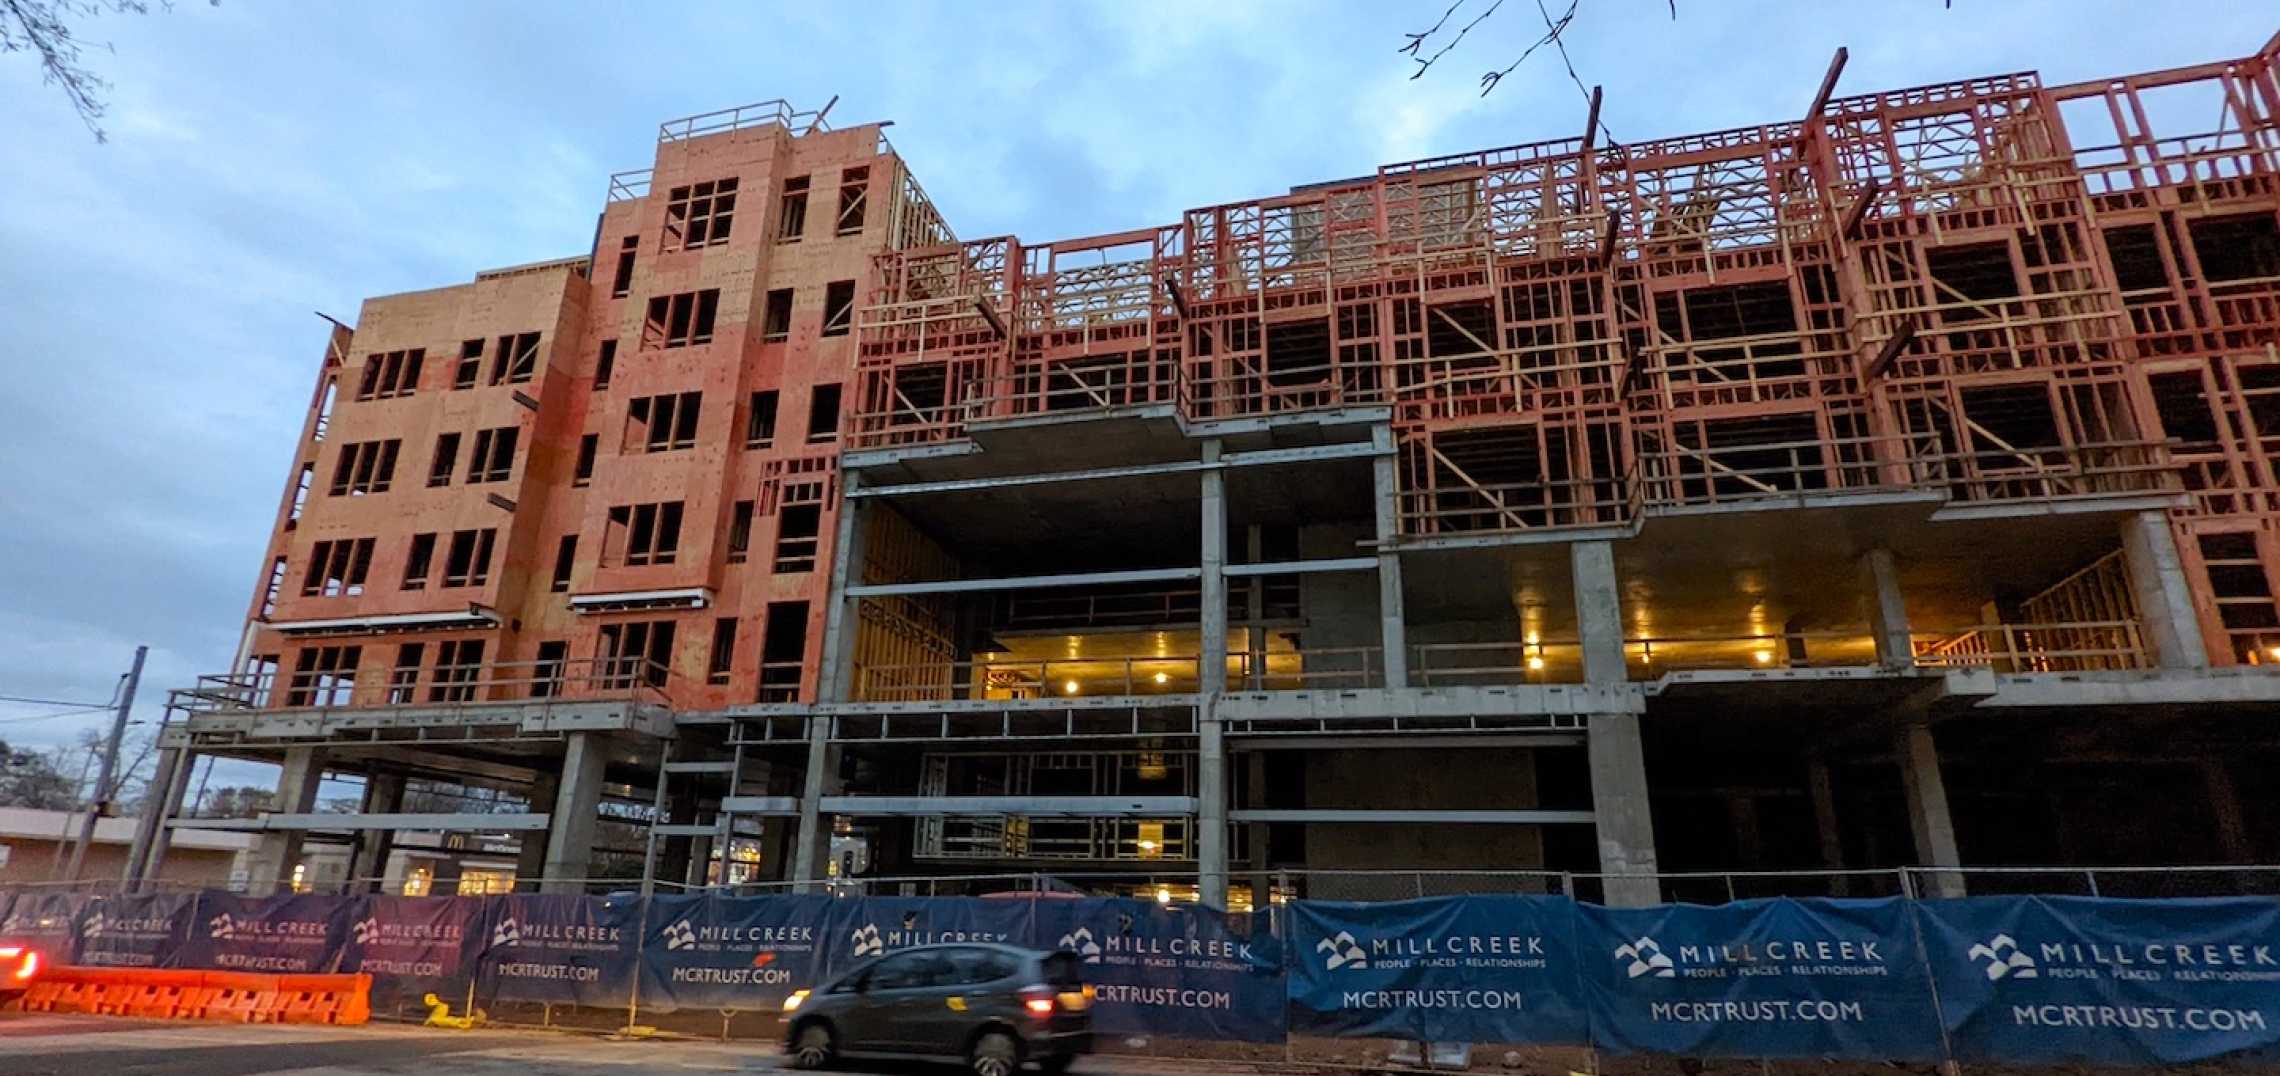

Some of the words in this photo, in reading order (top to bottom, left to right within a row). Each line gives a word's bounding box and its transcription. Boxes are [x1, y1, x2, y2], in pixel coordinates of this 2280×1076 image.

[235, 921, 273, 934] MILL
[276, 922, 328, 936] CREEK
[521, 924, 560, 939] MILL
[563, 925, 620, 941] CREEK
[700, 926, 742, 941] MILL
[748, 927, 812, 941] CREEK
[888, 931, 934, 946] MILL
[1372, 937, 1438, 955] MILL
[1446, 936, 1544, 955] CREEK
[1106, 936, 1161, 954] MILL
[1169, 938, 1253, 960] CREEK
[1680, 945, 1758, 963] MILL
[1766, 940, 1882, 961] CREEK
[2041, 942, 2134, 964] MILL
[2145, 944, 2278, 966] CREEK
[499, 963, 599, 981] MCRTRUST.COM
[1375, 960, 1410, 968] PEOPLE
[1420, 959, 1456, 967] PLACES
[1466, 958, 1546, 969] RELATIONSHIPS
[1684, 968, 1726, 978] PEOPLE
[1738, 967, 1781, 976] PLACES
[1792, 965, 1888, 976] RELATIONSHIPS
[672, 967, 791, 984] MCRTRUST.COM
[2049, 967, 2098, 979] PEOPLE
[2112, 967, 2161, 981] PLACES
[1094, 985, 1230, 1009] CRTRUST.COM
[1343, 990, 1521, 1010] MCRTRUST.COM
[1651, 1000, 1864, 1022] MCRTRUST.COM
[2012, 1004, 2267, 1031] MCRTRUST.COM
